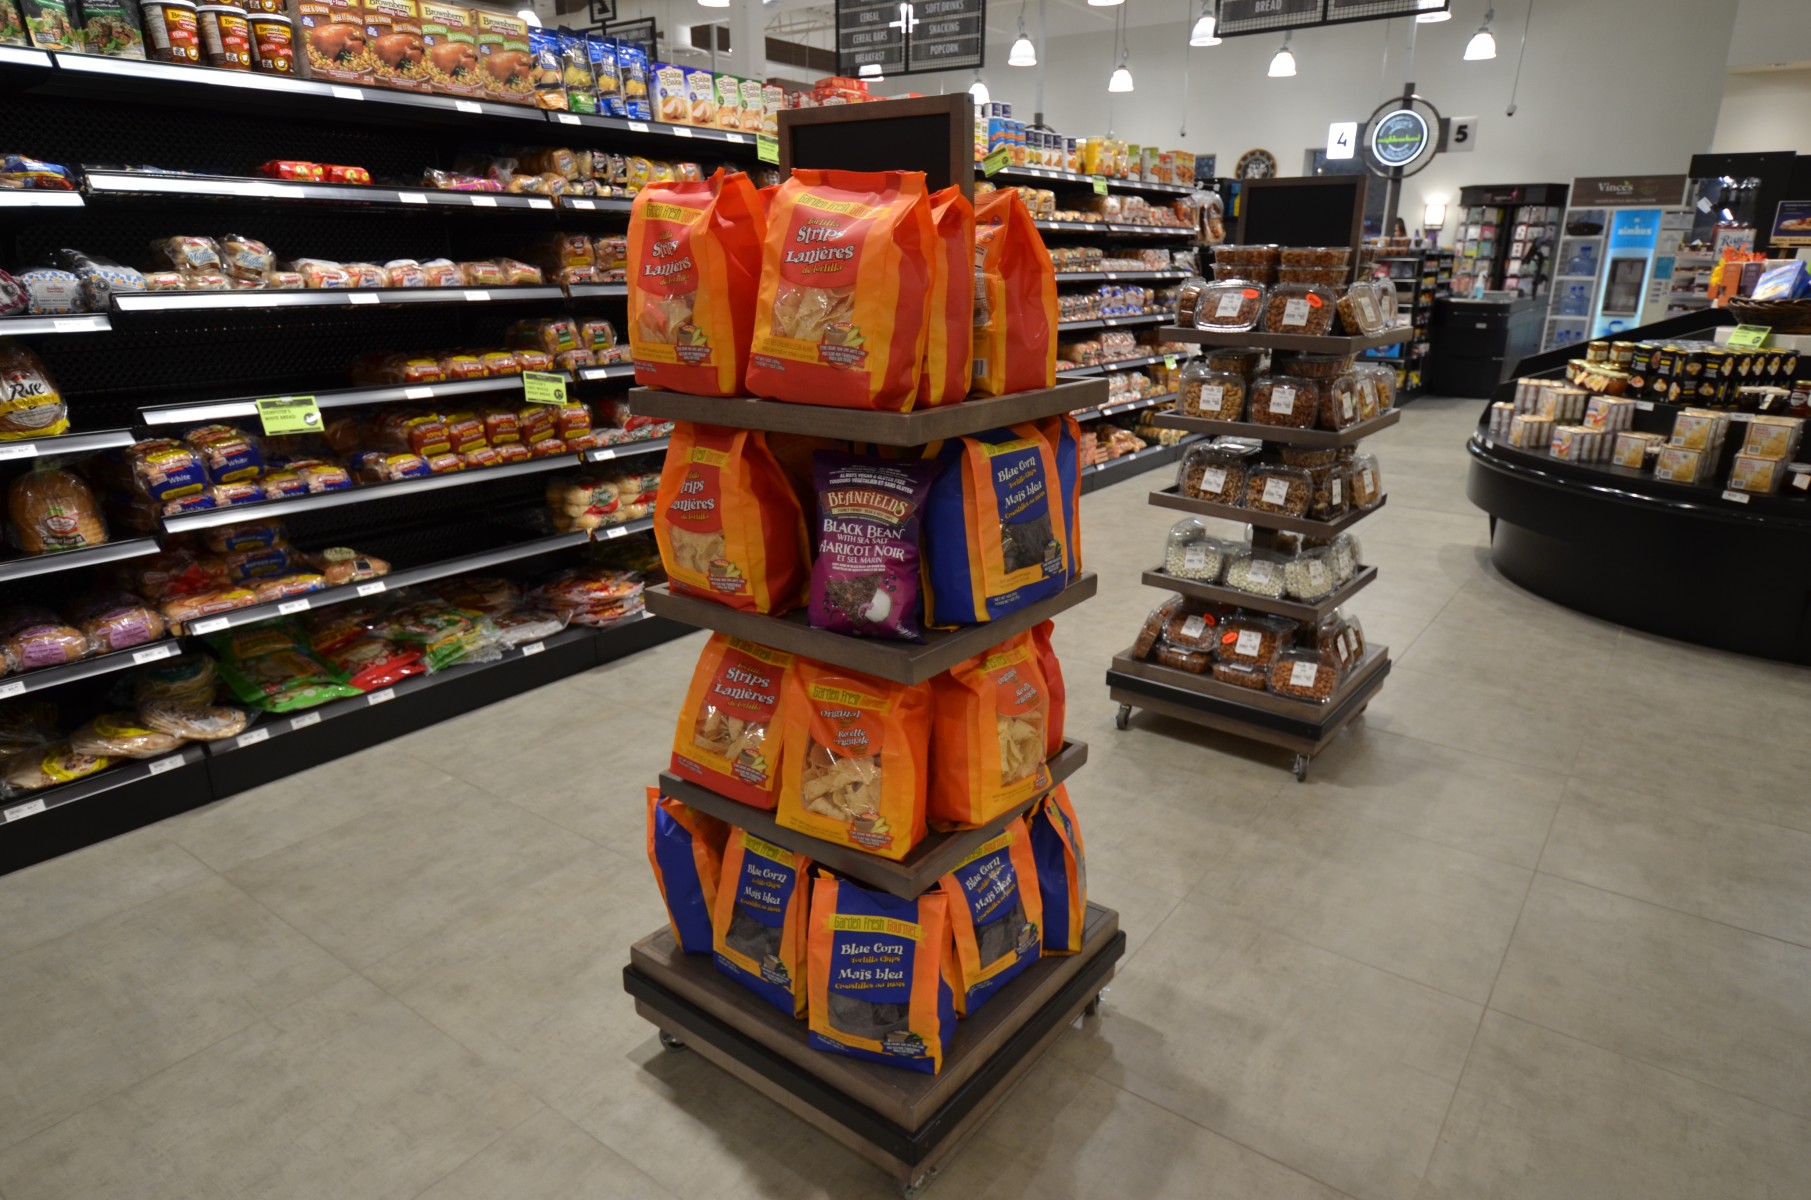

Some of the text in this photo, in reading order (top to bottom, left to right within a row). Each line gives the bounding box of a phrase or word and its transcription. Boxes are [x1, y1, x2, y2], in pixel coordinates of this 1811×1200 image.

[925, 0, 964, 14] SOFT DRINKS
[1254, 0, 1282, 13] BREAD
[424, 7, 465, 21] Brownberry
[860, 12, 880, 23] CEREAL
[483, 17, 523, 29] Brownberry
[929, 22, 960, 35] SNACKING
[853, 31, 887, 44] CEREAL BARS
[930, 43, 959, 55] POPCORN
[855, 52, 885, 63] BREAKFAST
[1336, 131, 1348, 147] 4
[1454, 124, 1469, 143] 5
[796, 226, 848, 244] Strips
[784, 245, 855, 264] Lanières
[997, 456, 1036, 483] Blue Corn
[168, 474, 191, 484] White
[680, 480, 705, 494] trips
[1026, 481, 1043, 496] bleu
[671, 498, 715, 512] anières
[823, 518, 906, 540] BLACK BEAN
[837, 533, 856, 543] WITH
[857, 536, 870, 544] SEA
[819, 540, 905, 562] HARICOT NOIR
[725, 667, 770, 687] Strips
[714, 683, 775, 704] Lanières
[813, 685, 839, 701] Garden
[841, 690, 861, 705] Fresh
[763, 868, 787, 883] Corn
[965, 856, 1001, 891] Blue Corn
[762, 891, 780, 905] bleu
[834, 916, 919, 939] Garden Fresh Gourmet
[840, 942, 903, 955] Blue Corn
[838, 968, 903, 980] Maïs bleu
